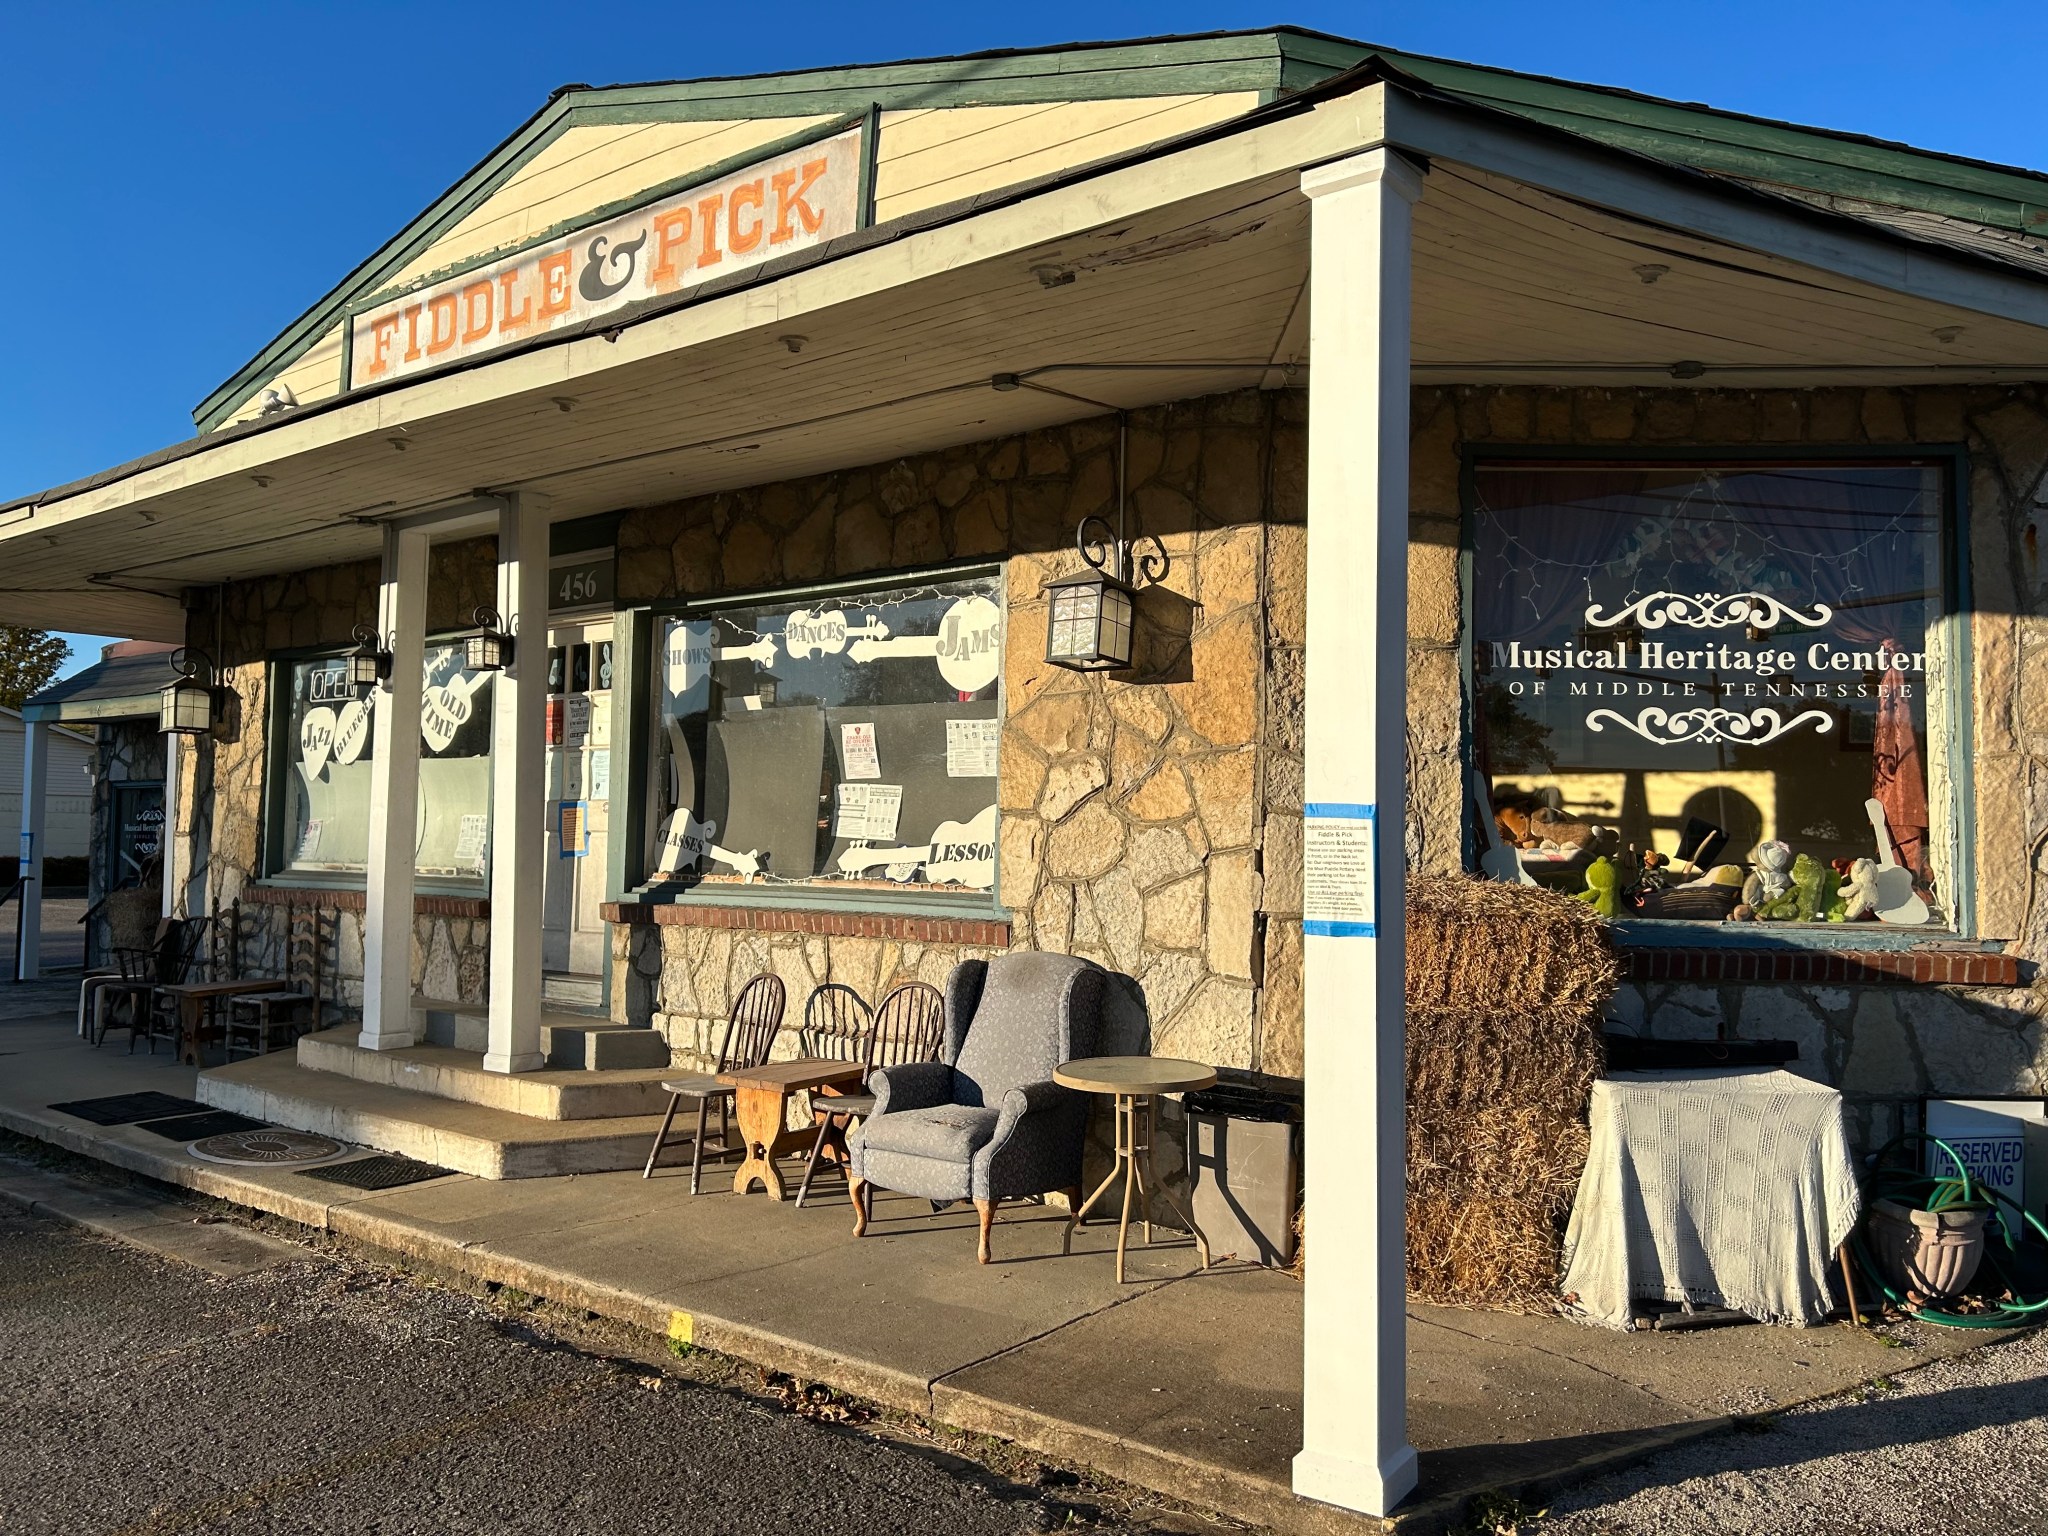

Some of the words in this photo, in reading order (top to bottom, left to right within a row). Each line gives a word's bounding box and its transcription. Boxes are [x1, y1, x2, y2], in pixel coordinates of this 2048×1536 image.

[369, 250, 573, 375] FIDDLE
[578, 228, 647, 301] &
[652, 158, 828, 282] PICK
[560, 570, 597, 601] 456
[788, 621, 845, 644] DANCES
[936, 615, 999, 661] JAMS
[663, 648, 711, 666] SHOWS
[1491, 641, 1628, 671] Musical
[1639, 642, 1796, 676] Heritage
[1807, 642, 1926, 672] Center
[312, 671, 355, 699] OPEN
[1508, 681, 1546, 696] OF
[1570, 681, 1696, 697] MIDDLE
[1721, 682, 1913, 698] TENNESSEE
[421, 694, 454, 739] TIME
[440, 689, 466, 720] OLD
[303, 723, 331, 751] JAZZ
[657, 829, 705, 853] CLASSES
[1945, 1165, 2015, 1186] PKING
